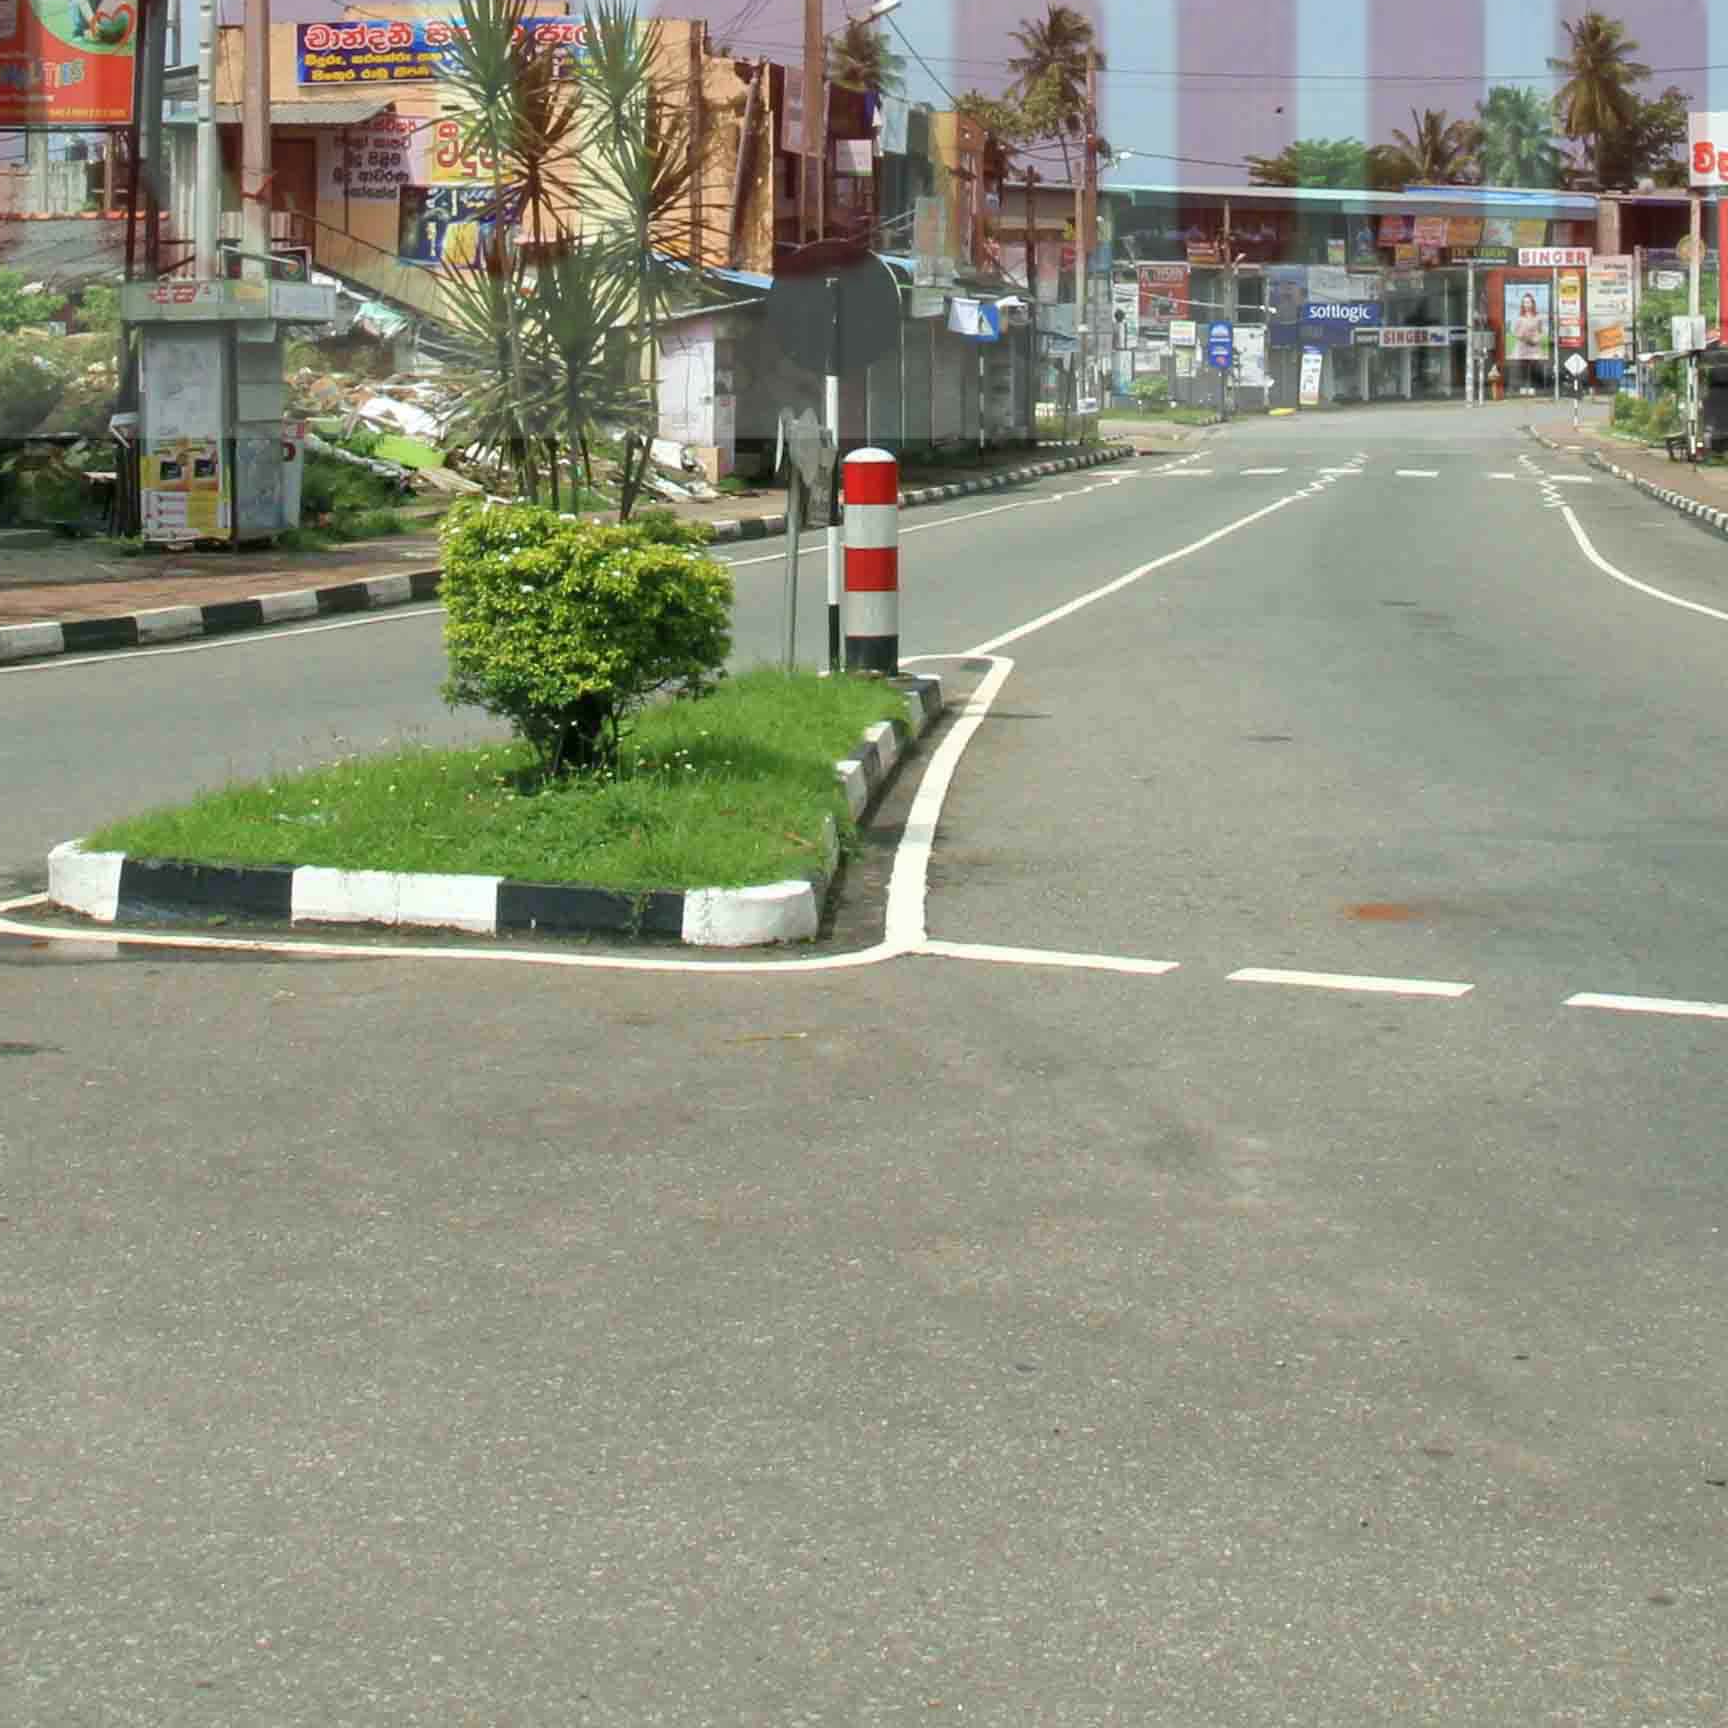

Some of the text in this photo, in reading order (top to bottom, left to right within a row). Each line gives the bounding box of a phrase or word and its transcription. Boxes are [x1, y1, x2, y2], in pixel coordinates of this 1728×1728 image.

[1519, 251, 1588, 266] SINGER
[1309, 302, 1371, 323] softlogic
[1382, 329, 1429, 345] SINGER
